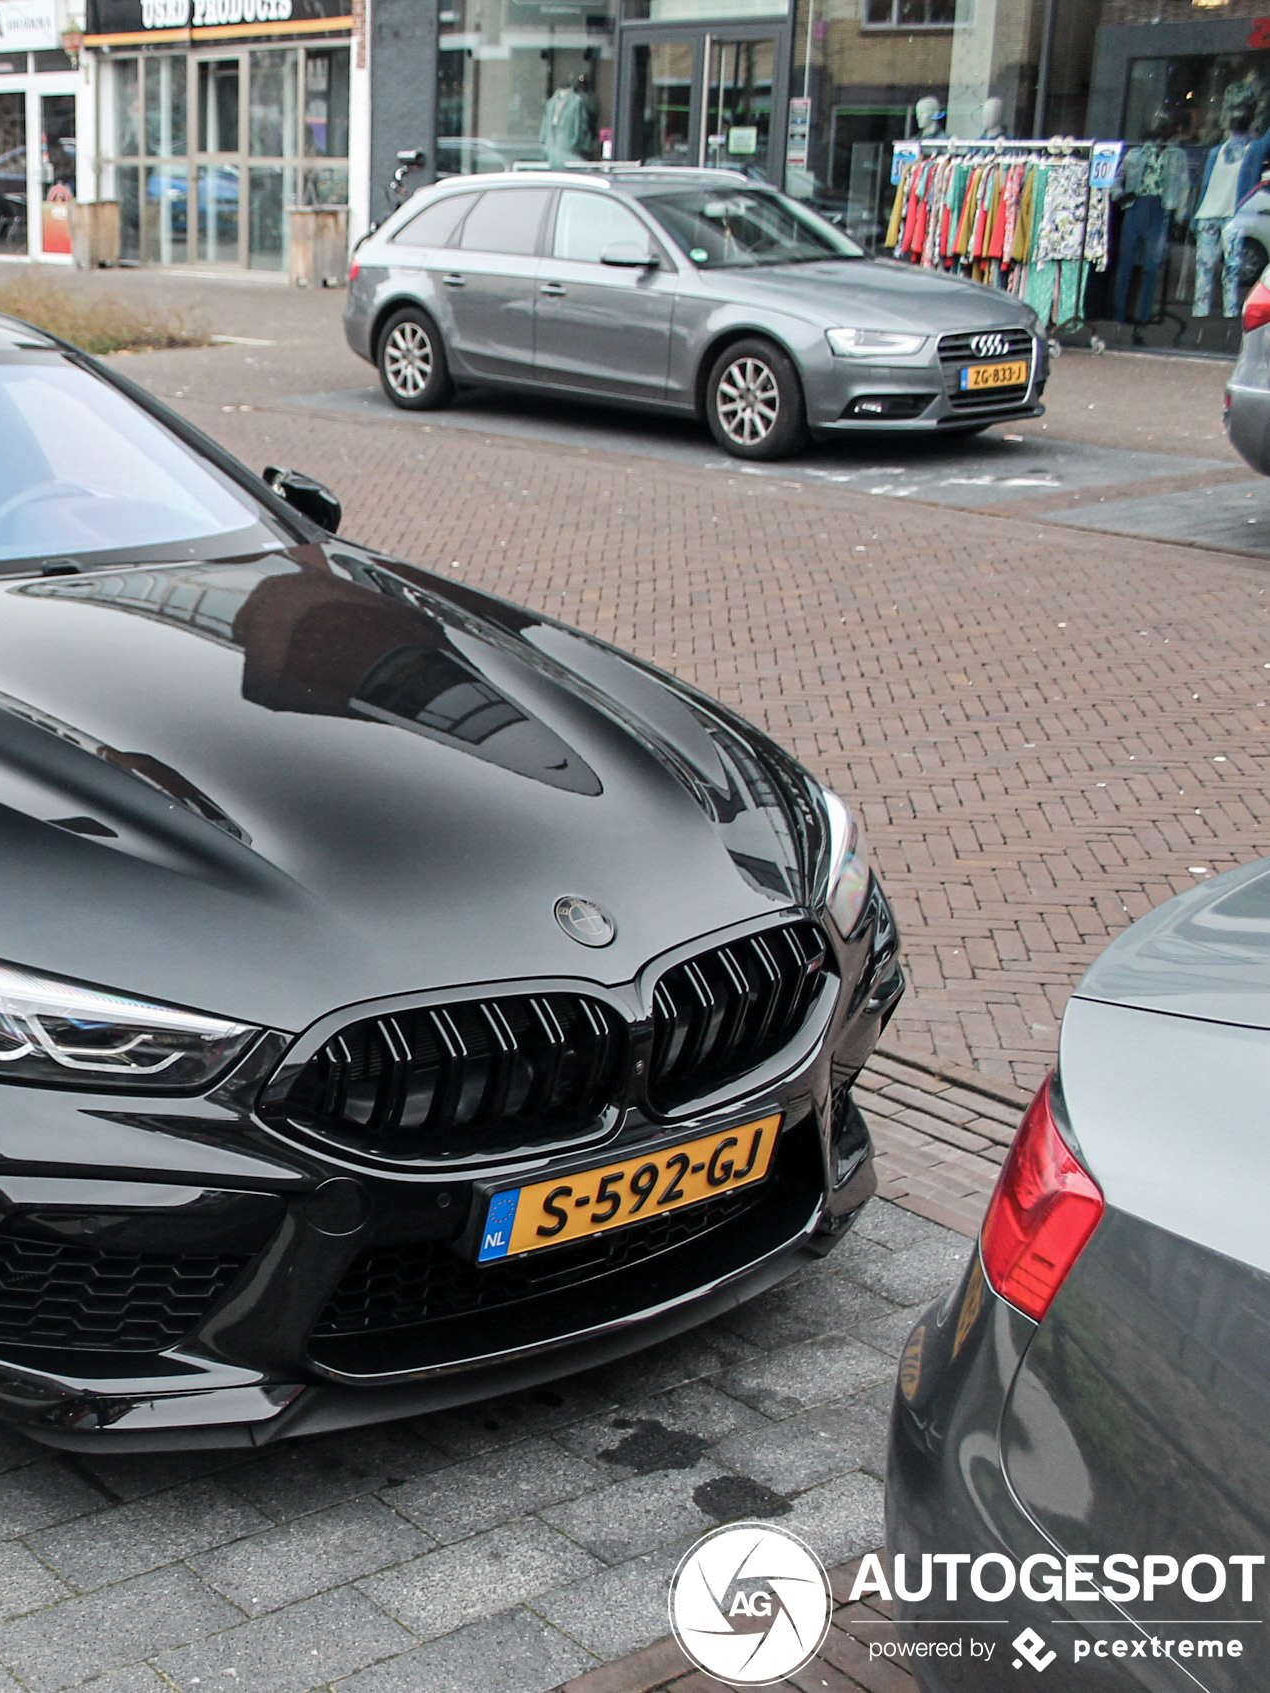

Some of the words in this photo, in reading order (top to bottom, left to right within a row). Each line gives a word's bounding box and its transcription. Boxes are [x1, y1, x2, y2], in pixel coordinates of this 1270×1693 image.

[141, 0, 189, 29] USED
[192, 0, 292, 27] PRODUCTS
[973, 365, 1022, 386] ZG-833-J
[536, 1128, 763, 1237] S-592-GJ
[484, 1230, 506, 1250] NL
